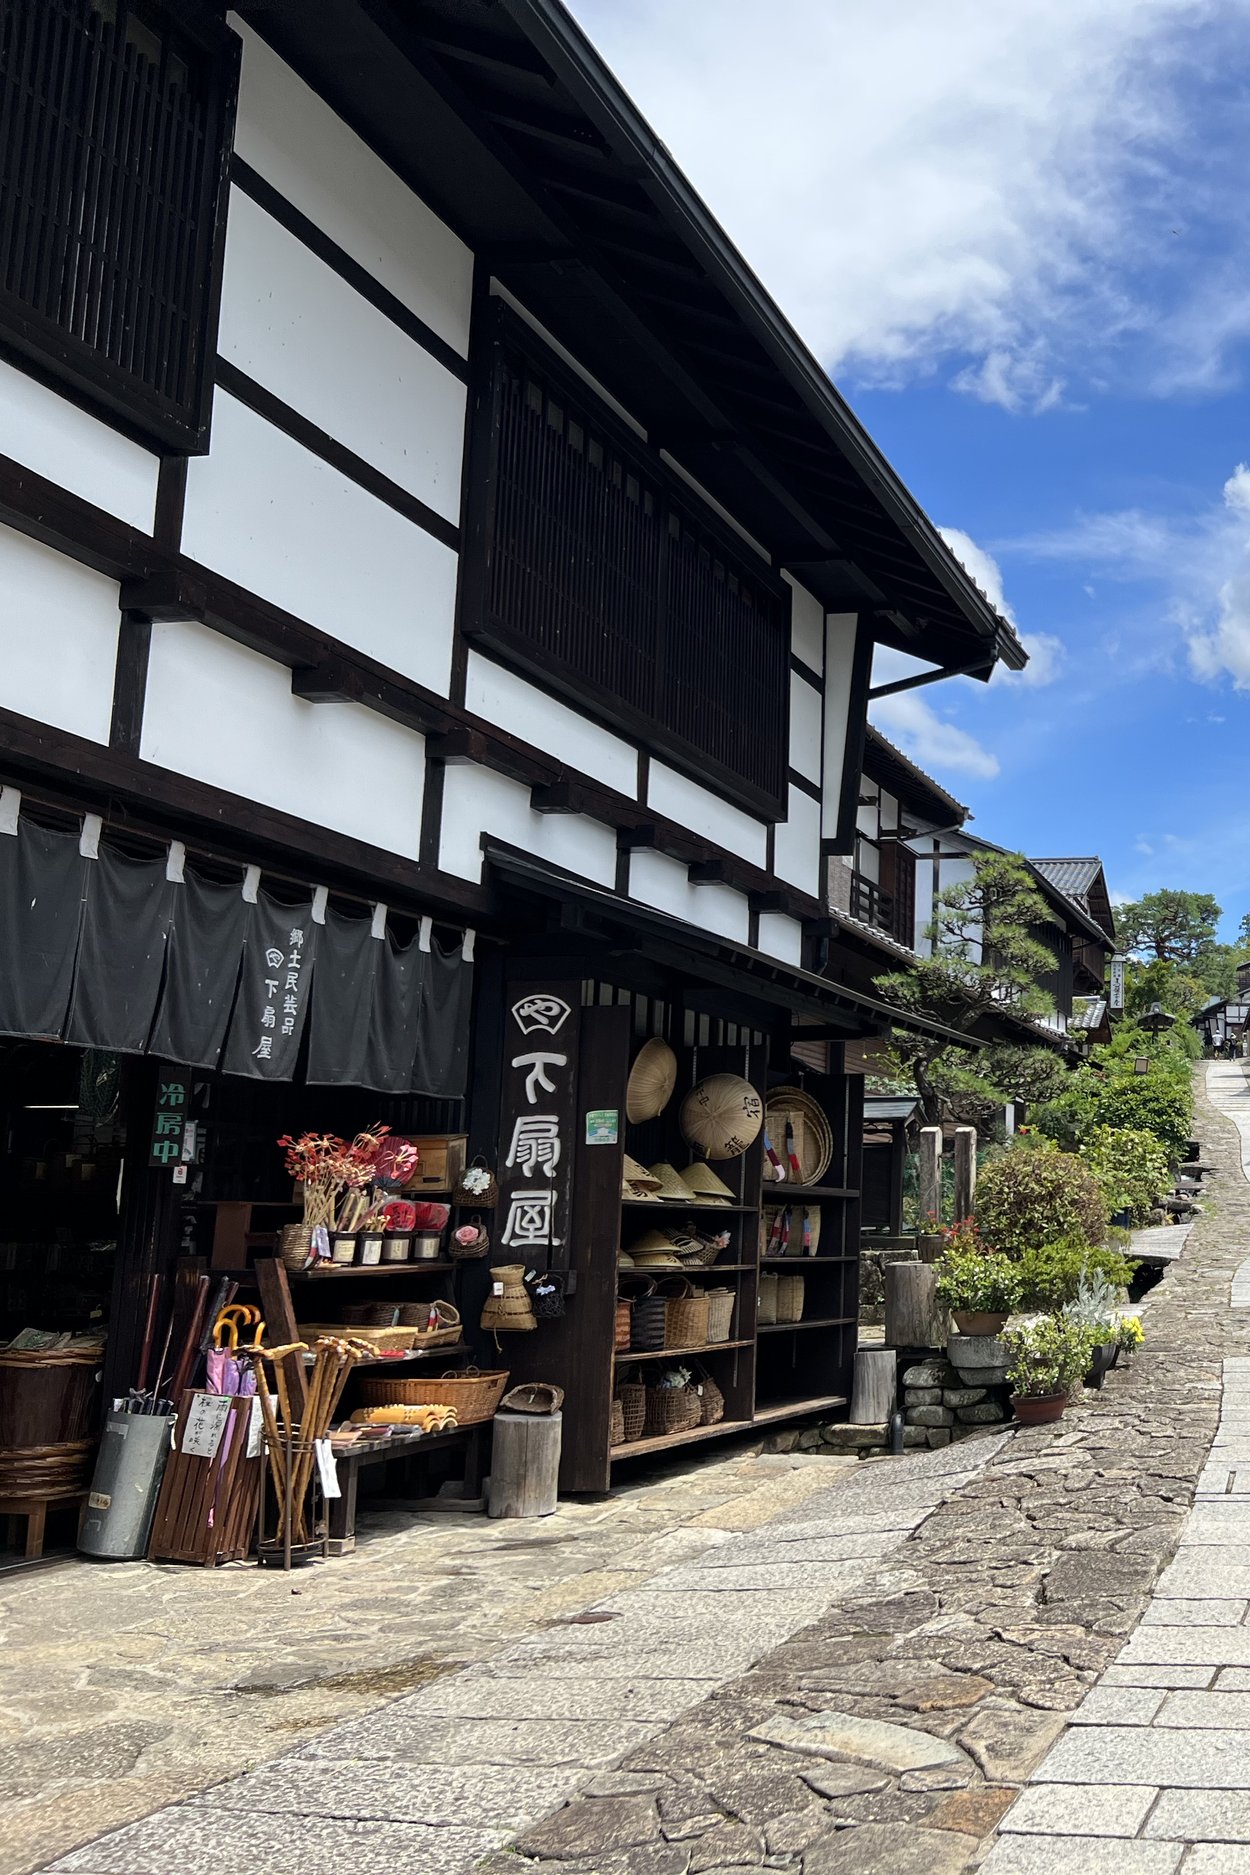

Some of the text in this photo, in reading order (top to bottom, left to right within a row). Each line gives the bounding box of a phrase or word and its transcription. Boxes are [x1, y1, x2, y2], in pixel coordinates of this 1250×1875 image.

[251, 979, 279, 1060] 下扇屋
[281, 928, 304, 1036] 郷土民芸品
[153, 1083, 186, 1163] 冷房中
[501, 1052, 568, 1247] 下扇屋
